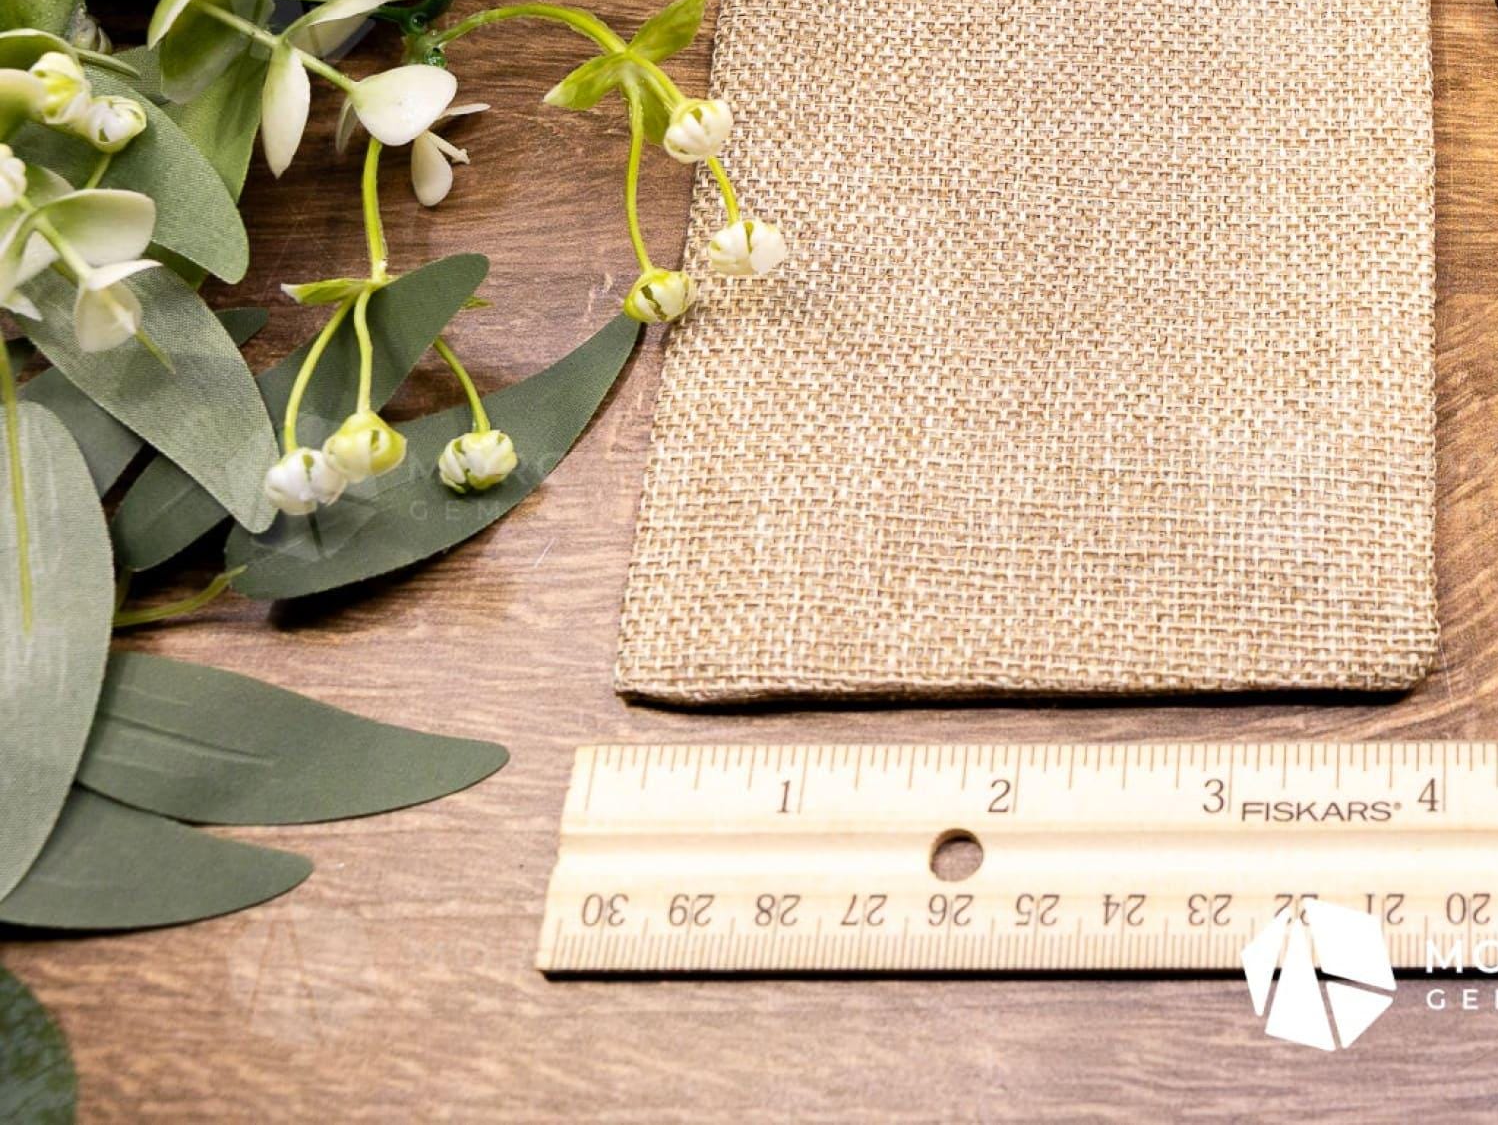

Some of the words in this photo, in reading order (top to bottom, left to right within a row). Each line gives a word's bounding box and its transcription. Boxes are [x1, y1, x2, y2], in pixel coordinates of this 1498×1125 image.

[776, 780, 791, 813] 1
[988, 779, 1011, 813] 2
[1203, 779, 1225, 813] 3
[1417, 778, 1439, 812] 4
[581, 893, 629, 926] 30
[668, 894, 715, 926] 29
[754, 894, 801, 926] 28
[841, 894, 887, 926] 27
[928, 894, 974, 926] 26
[1015, 893, 1060, 926] 25
[1103, 894, 1147, 926] 24
[1187, 894, 1232, 926] 23
[1365, 893, 1405, 925] 21
[1446, 893, 1491, 925] 20
